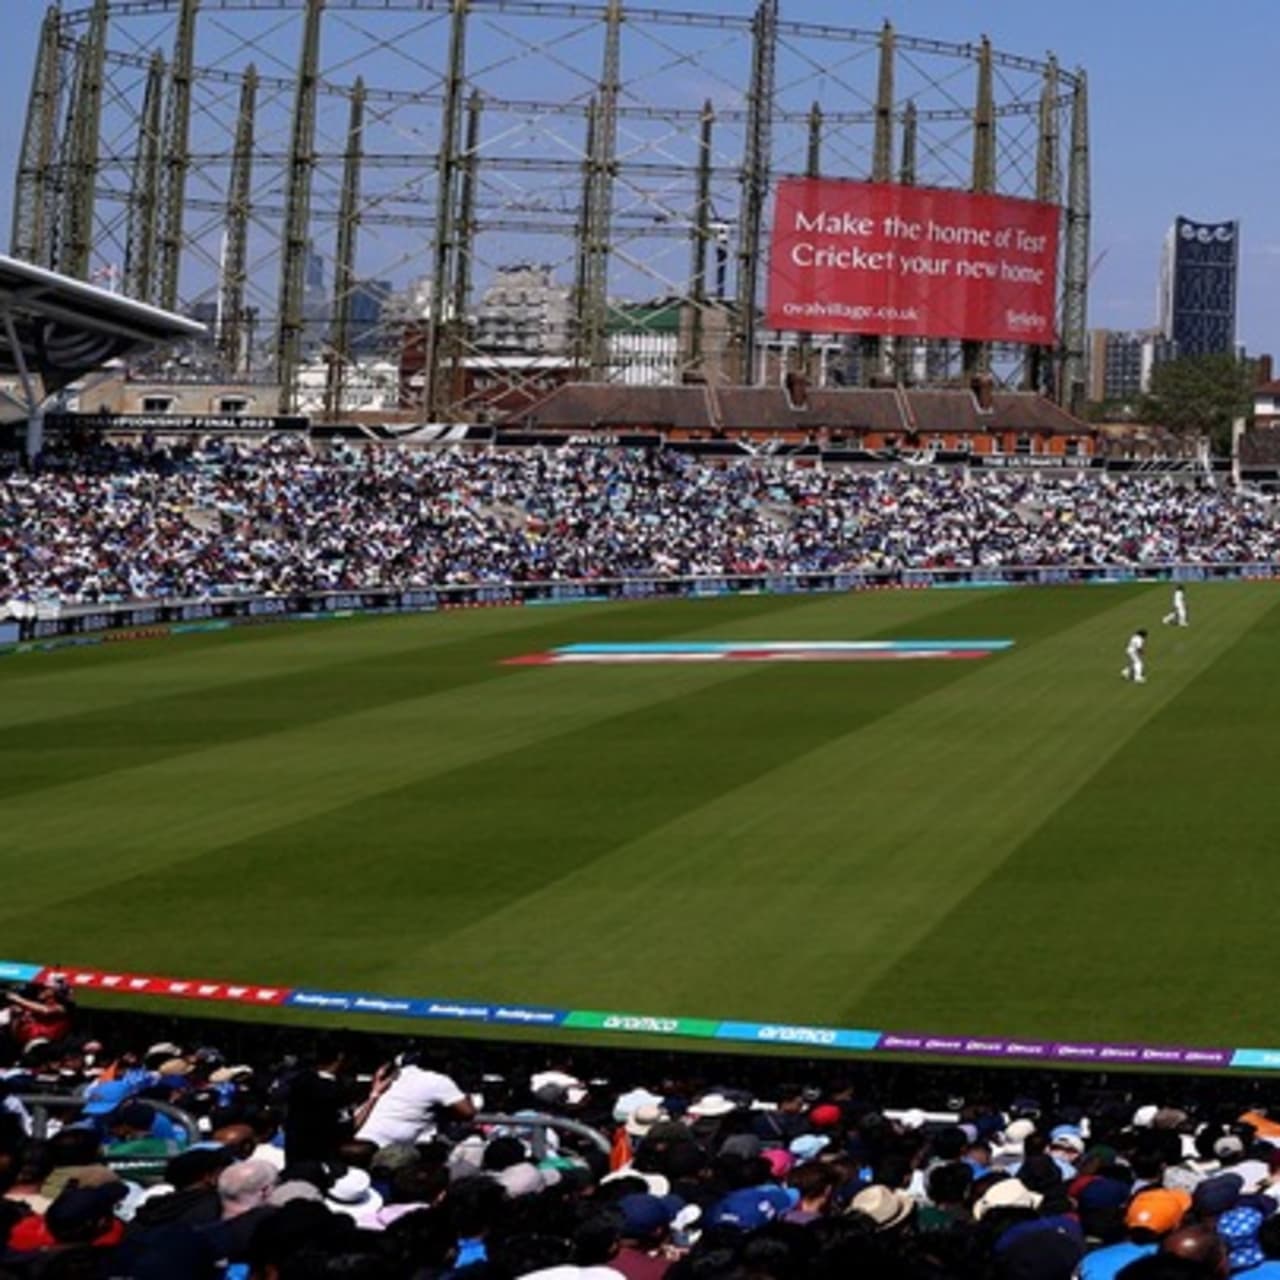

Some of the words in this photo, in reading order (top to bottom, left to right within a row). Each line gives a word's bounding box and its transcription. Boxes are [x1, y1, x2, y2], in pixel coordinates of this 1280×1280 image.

[795, 211, 873, 235] Make
[884, 215, 921, 240] the
[927, 219, 990, 247] home
[994, 227, 1013, 247] of
[1016, 229, 1046, 252] Test
[792, 242, 894, 270] Cricket
[900, 253, 951, 276] your
[956, 260, 997, 279] new
[1001, 263, 1044, 285] home
[783, 302, 919, 320] ovalvillage.co.uk
